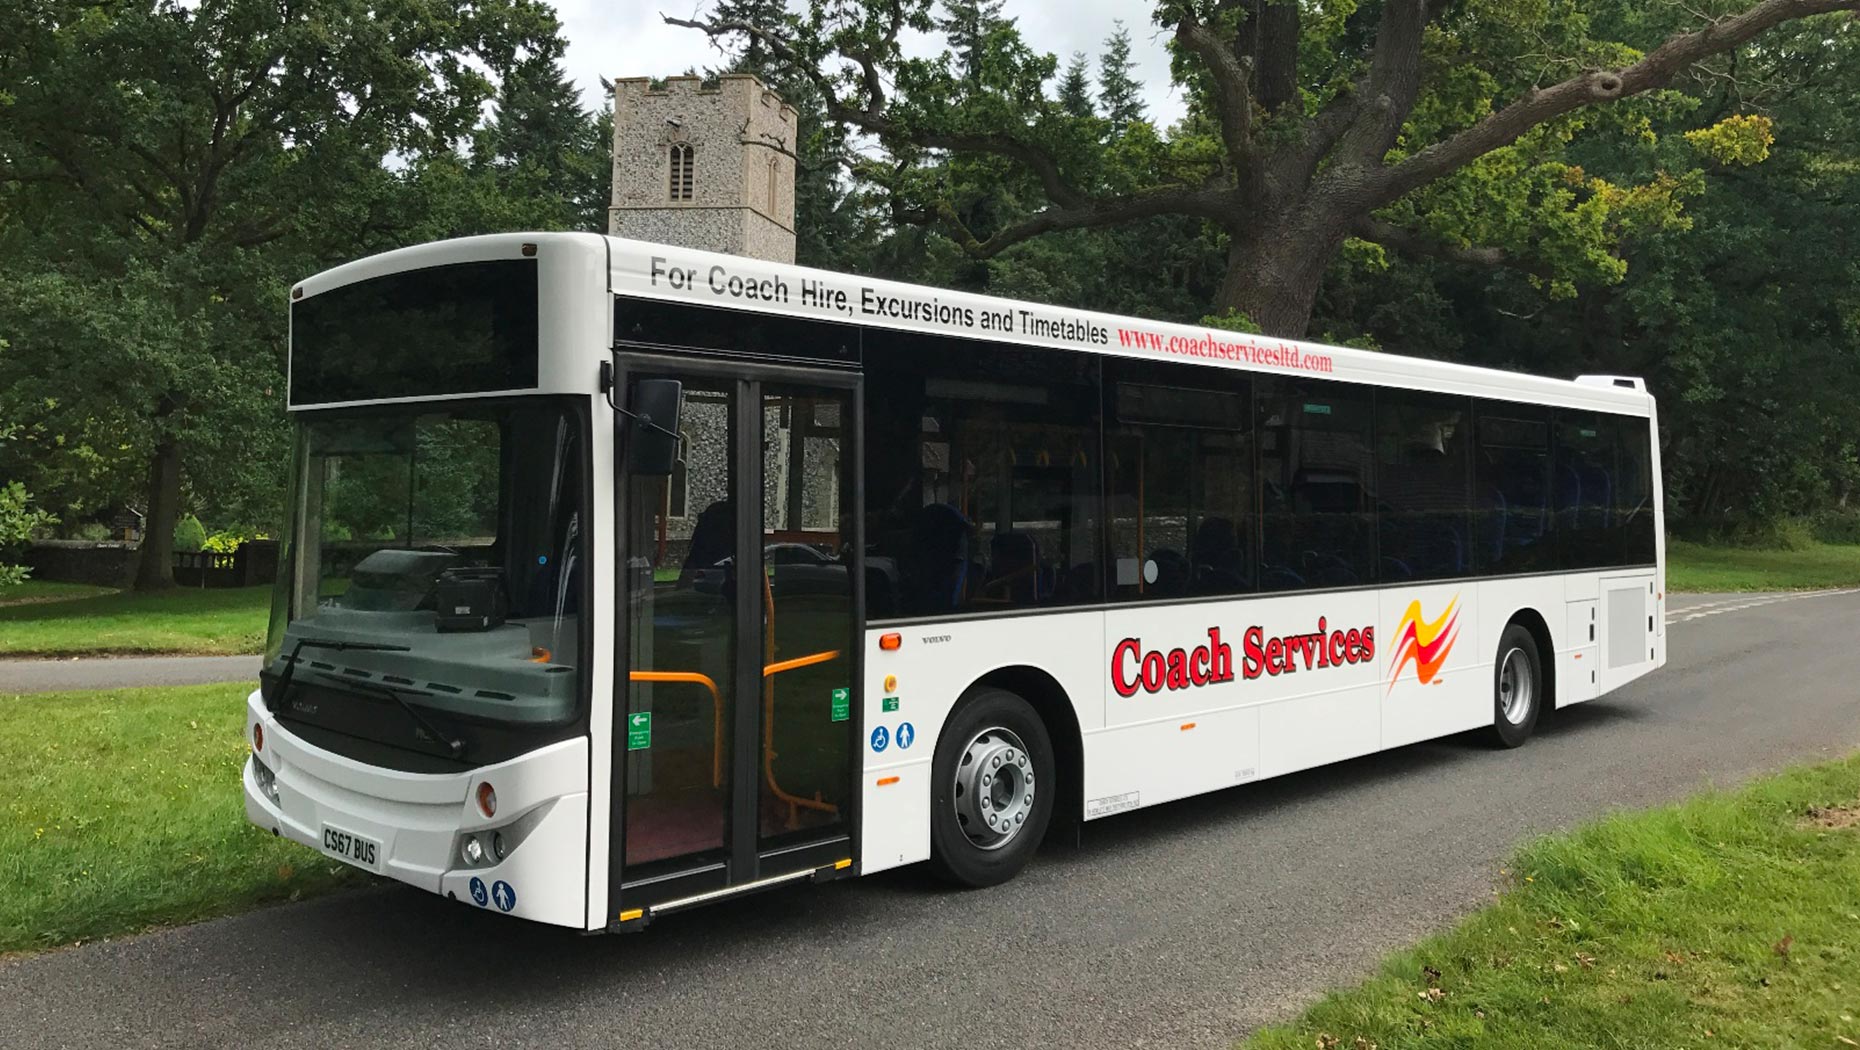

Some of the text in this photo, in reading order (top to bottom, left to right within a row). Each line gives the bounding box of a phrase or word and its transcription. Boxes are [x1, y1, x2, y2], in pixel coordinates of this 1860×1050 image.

[651, 256, 1109, 345] For Coach Hire, Excursions and Timetables
[1117, 328, 1333, 373] www.coachservicesltd.com
[922, 634, 952, 644] VOLVO
[1111, 616, 1375, 698] Coach Services
[324, 828, 376, 865] CS67 BUS
